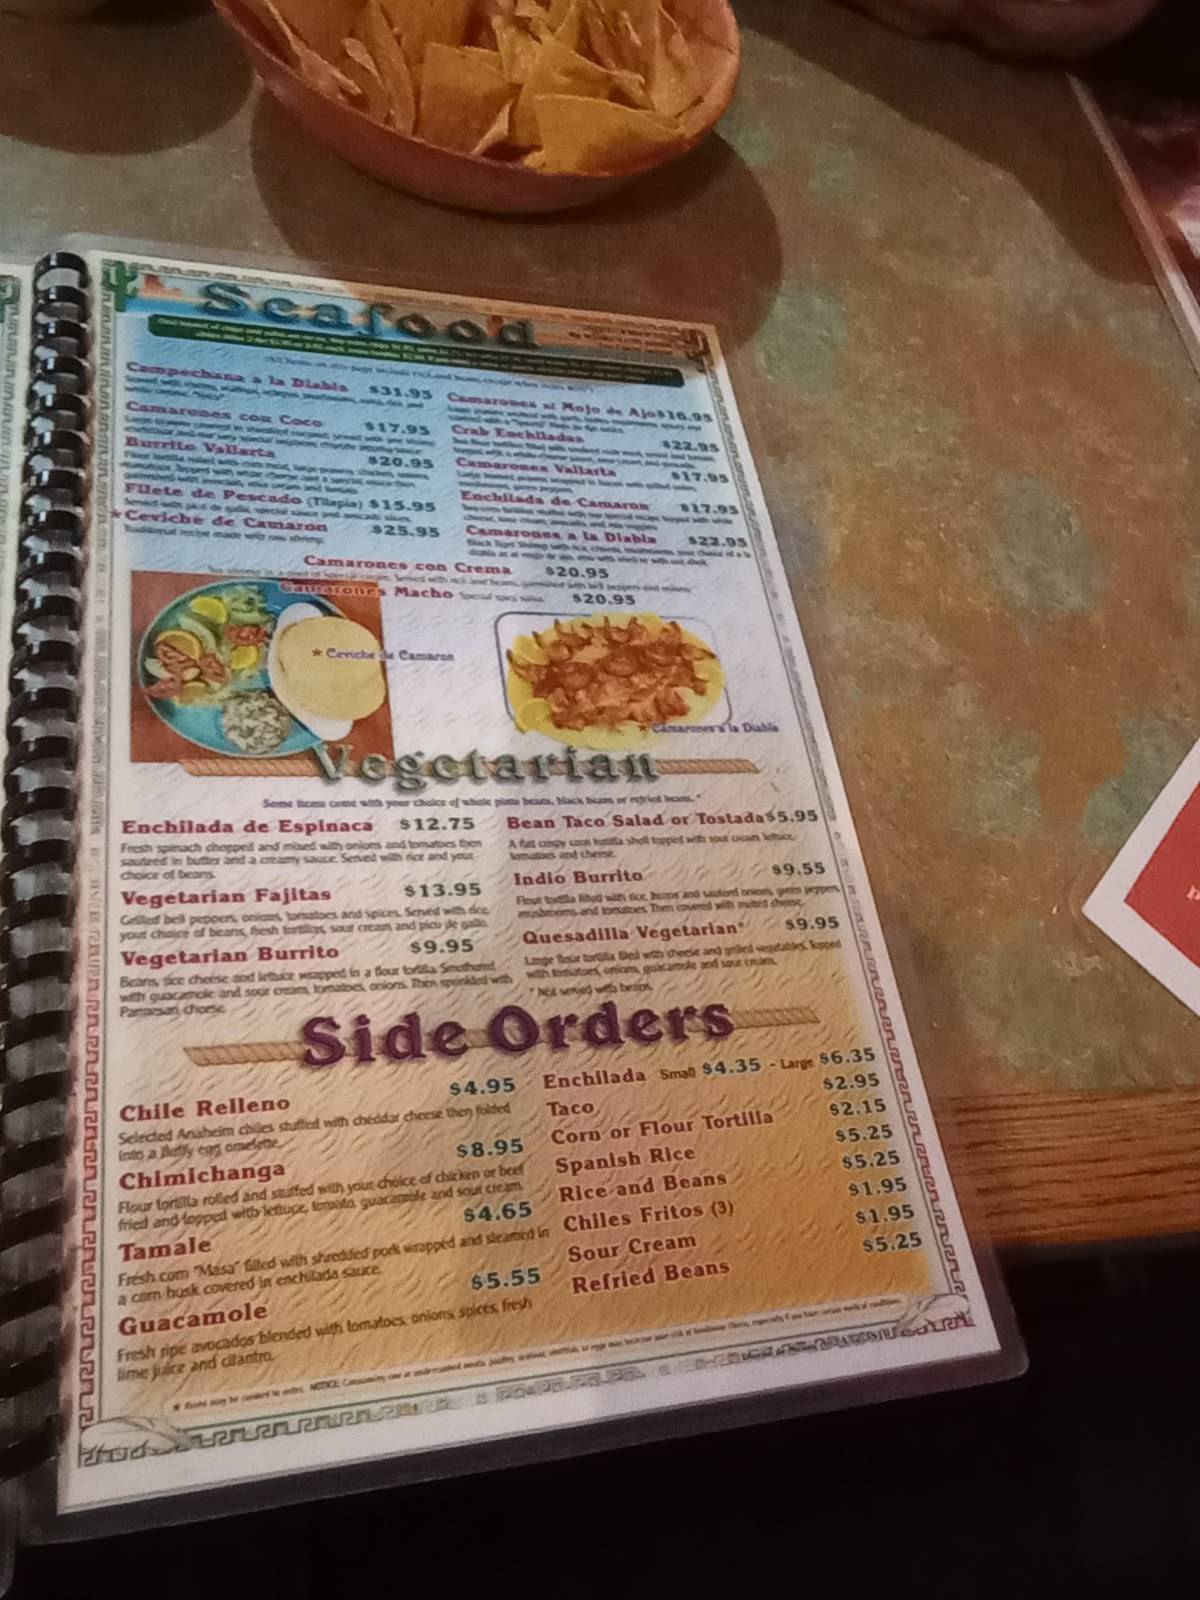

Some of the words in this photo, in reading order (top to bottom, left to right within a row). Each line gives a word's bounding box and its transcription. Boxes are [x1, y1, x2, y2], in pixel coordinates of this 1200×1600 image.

[201, 282, 538, 349] Seafood
[126, 361, 245, 383] Campechana
[252, 376, 262, 384] a
[268, 375, 285, 387] la
[369, 385, 433, 400] $31.95
[126, 401, 231, 420] Camarones
[239, 412, 271, 422] con
[280, 414, 323, 428] Coco
[365, 420, 430, 436] $17.95
[447, 392, 537, 409] Camarones
[561, 401, 600, 416] Mojo
[606, 405, 622, 415] de
[629, 406, 656, 419] Ajo
[452, 424, 489, 437] Crab
[496, 427, 584, 444] Enchiladas
[126, 437, 195, 451] Burrito
[205, 440, 275, 458] Vallarta
[368, 456, 434, 470] $20.95
[456, 457, 548, 474] Camarones
[553, 463, 616, 478] Vallarta
[671, 470, 729, 483] $17.95
[125, 483, 182, 498] Filete
[192, 487, 213, 500] de
[223, 489, 301, 505] Pescado
[307, 496, 363, 511] (Tilapia)
[369, 499, 436, 513] $15.95
[461, 490, 545, 506] Enchilada
[551, 496, 570, 508] de
[576, 497, 650, 512] Camaron
[125, 509, 207, 525] Ceviche
[212, 514, 235, 527] de
[243, 517, 328, 533] Camaron
[372, 524, 440, 538] $25.95
[466, 525, 560, 541] Camarones
[567, 532, 577, 541] a
[582, 531, 598, 542] la
[304, 554, 408, 571] Camarones
[415, 560, 447, 572] con
[455, 562, 512, 575] Crema
[546, 566, 609, 578] $20.95
[394, 586, 453, 600] Macho
[572, 593, 635, 605] $20.95
[326, 647, 376, 660] Ceviche
[399, 650, 454, 661] Camaron
[311, 744, 659, 791] Vegetarian
[121, 820, 233, 835] Enchilada
[243, 820, 269, 833] de
[279, 819, 373, 836] Espinaca
[400, 818, 475, 831] $12.75
[507, 816, 554, 830] Bean
[562, 815, 604, 828] Taco
[612, 813, 663, 827] Salad
[671, 816, 690, 826] or
[697, 812, 764, 825] Tostada
[765, 810, 818, 823] $5.95
[513, 871, 566, 885] Indio
[574, 869, 643, 884] Burrito
[772, 862, 825, 876] $9.55
[121, 890, 245, 909] Vegetarian
[255, 888, 331, 904] Fajitas
[404, 882, 481, 897] $13.95
[341, 908, 362, 919] and
[405, 906, 440, 916] Served
[443, 906, 465, 915] with
[522, 926, 629, 944] Quesadilla
[785, 916, 839, 931] $9.95
[121, 950, 247, 969] Vegetarian
[258, 945, 339, 961] Burrito
[410, 939, 474, 954] $9.95
[302, 1011, 468, 1066] Side
[490, 1001, 734, 1053] Orders
[542, 1069, 646, 1090] Enchilada
[660, 1068, 696, 1081] Small
[702, 1058, 761, 1075] $4.35
[780, 1057, 814, 1070] Large
[819, 1048, 876, 1066] $6.35
[120, 1104, 184, 1122] Chile
[196, 1097, 290, 1117] Relleno
[450, 1077, 516, 1096] $4.95
[547, 1101, 594, 1117] Taco
[823, 1073, 880, 1090] $2.95
[551, 1127, 601, 1145] Corn
[611, 1126, 631, 1139] or
[640, 1119, 693, 1136] Flour
[702, 1111, 774, 1131] Tortilla
[830, 1099, 887, 1116] $2.15
[118, 1164, 285, 1190] Chimichanga
[456, 1138, 524, 1158] $8.95
[555, 1153, 641, 1177] Spanish
[649, 1148, 696, 1164] Rice
[835, 1124, 893, 1143] $5.25
[559, 1185, 607, 1202] Rice
[616, 1178, 655, 1195] and
[663, 1172, 727, 1191] Beans
[842, 1150, 900, 1170] $5.25
[563, 1212, 631, 1232] Chiles
[640, 1201, 703, 1223] Fritos
[711, 1200, 734, 1219] (3)
[848, 1177, 907, 1196] $1.95
[118, 1236, 212, 1262] Tamale
[463, 1201, 532, 1222] $4.65
[567, 1244, 620, 1264] Sour
[628, 1233, 697, 1255] Cream
[855, 1204, 914, 1224] $1.95
[572, 1270, 655, 1294] Refried
[663, 1260, 730, 1281] Beans
[863, 1231, 922, 1253] $5.25
[118, 1295, 126, 1305] a
[166, 1284, 199, 1299] husk
[203, 1278, 255, 1295] covered
[259, 1276, 272, 1289] in
[276, 1268, 339, 1286] enchilada
[118, 1303, 269, 1336] Guacamole
[471, 1267, 541, 1291] $5.55
[117, 1347, 155, 1362] Fresh
[161, 1344, 187, 1360] ripe
[191, 1335, 254, 1354] avocados
[258, 1327, 311, 1345] blended
[316, 1321, 343, 1337] with
[502, 1297, 532, 1312] fresh
[117, 1367, 149, 1382] lime
[152, 1361, 185, 1382] juice
[190, 1356, 217, 1372] and
